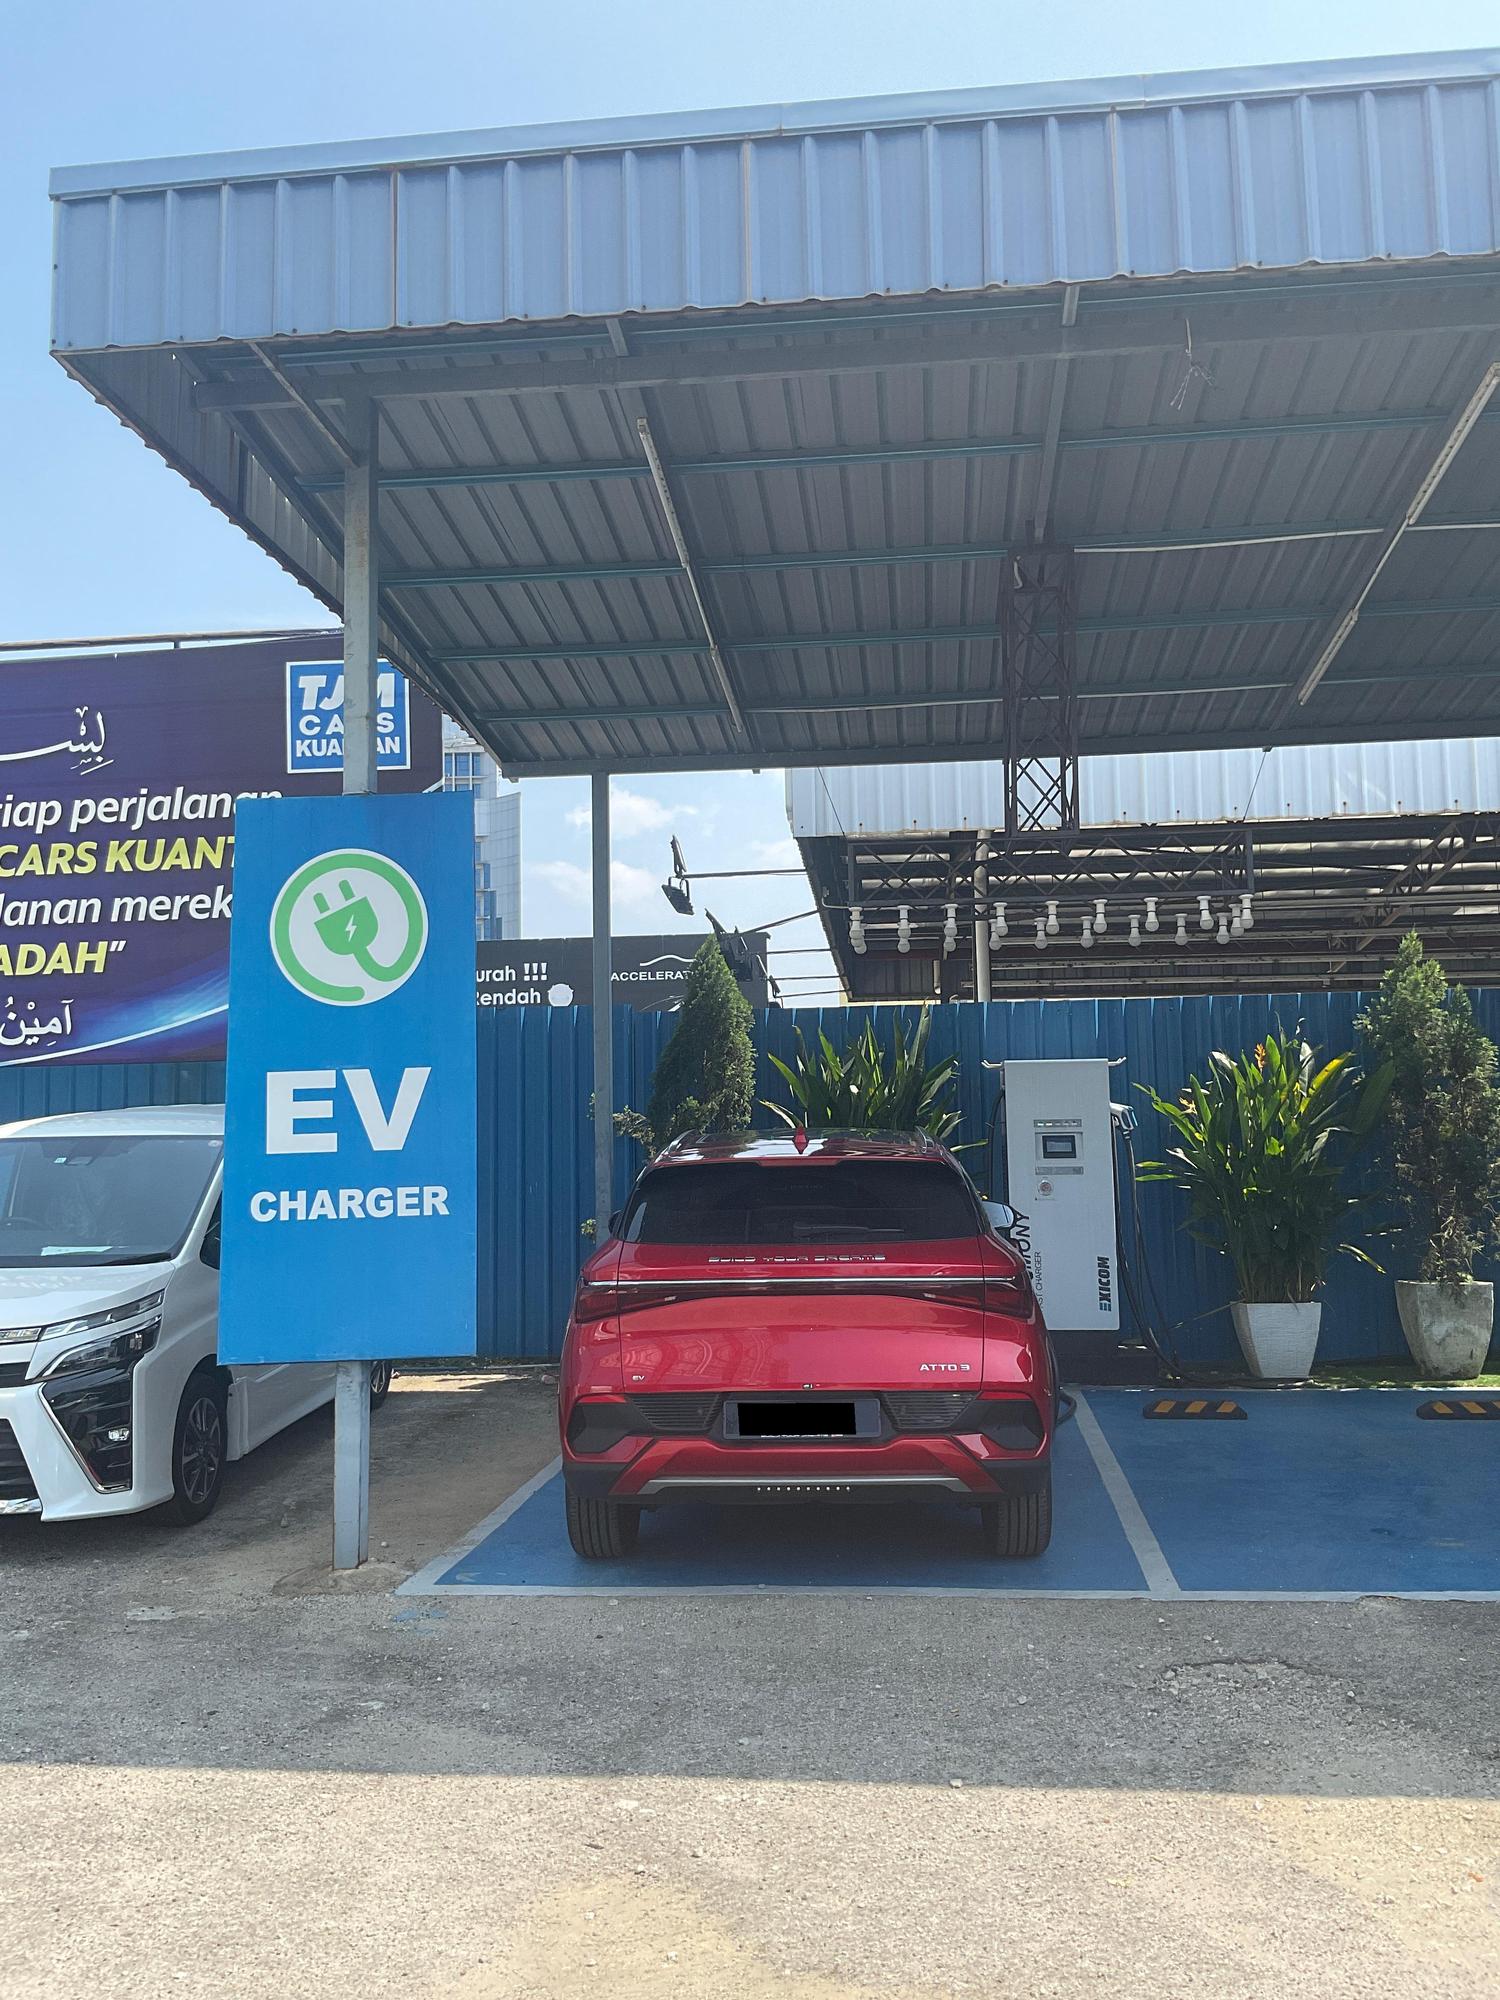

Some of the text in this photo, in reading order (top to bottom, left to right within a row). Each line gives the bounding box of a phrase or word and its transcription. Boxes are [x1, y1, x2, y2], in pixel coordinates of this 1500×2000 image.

[299, 712, 395, 736] CAS
[0, 794, 62, 834] iap
[266, 1066, 432, 1155] EV
[250, 1186, 450, 1222] CHARGER
[1097, 1256, 1112, 1312] EXICOM
[919, 1363, 970, 1371] ATTO 3
